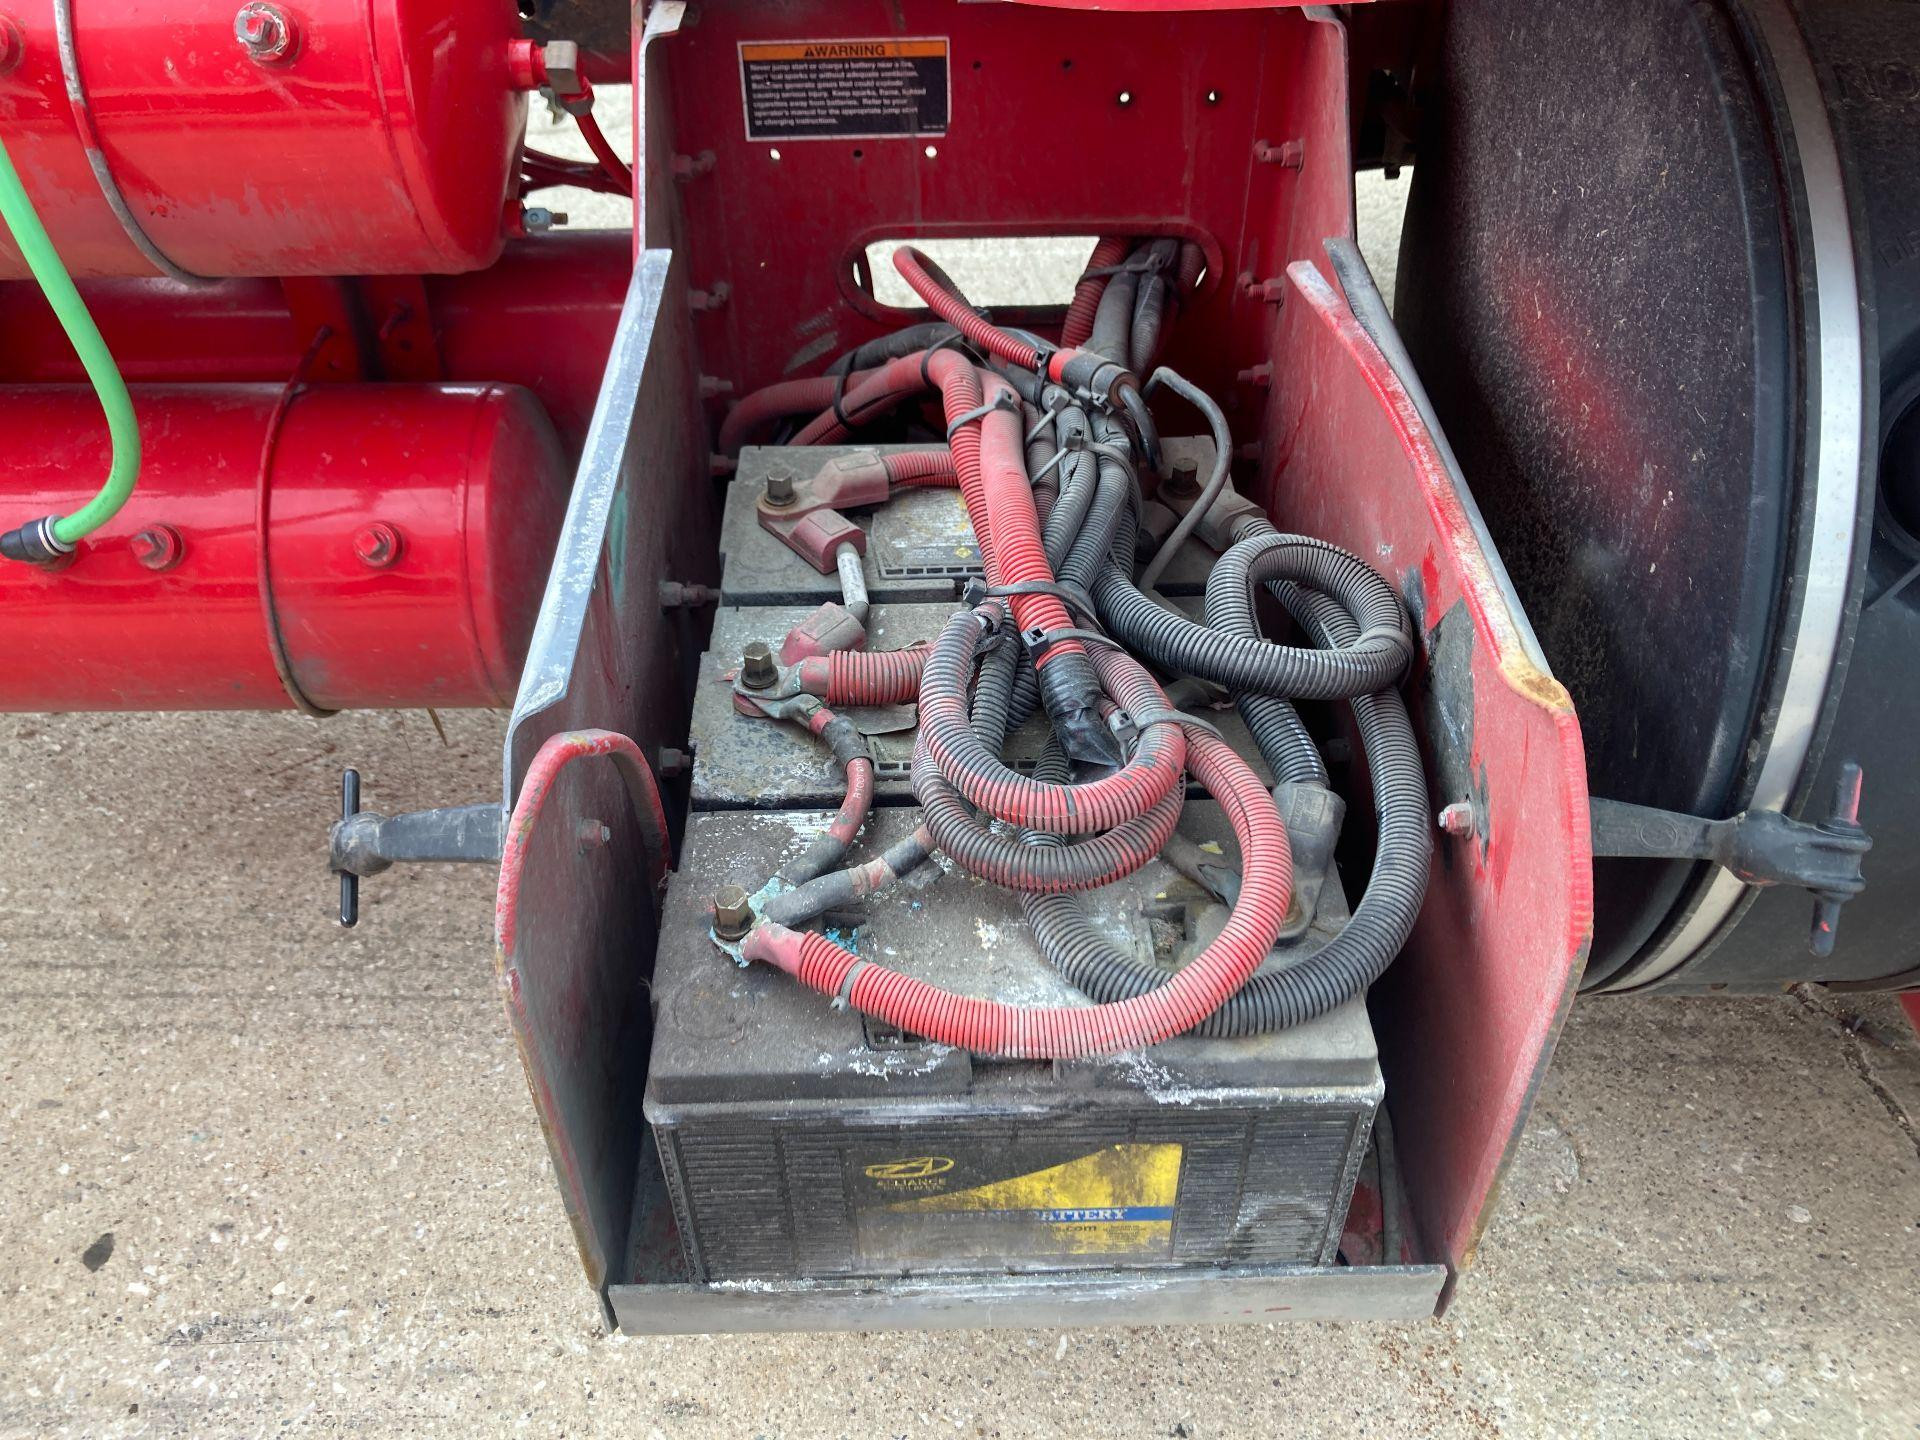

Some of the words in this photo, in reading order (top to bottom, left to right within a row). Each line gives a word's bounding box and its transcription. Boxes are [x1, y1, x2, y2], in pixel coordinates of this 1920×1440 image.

[814, 44, 885, 57] WARNING
[818, 63, 843, 71] charge
[850, 62, 876, 70] battery
[846, 71, 879, 79] adequate
[840, 107, 881, 116] appropriate
[763, 119, 794, 127] charging
